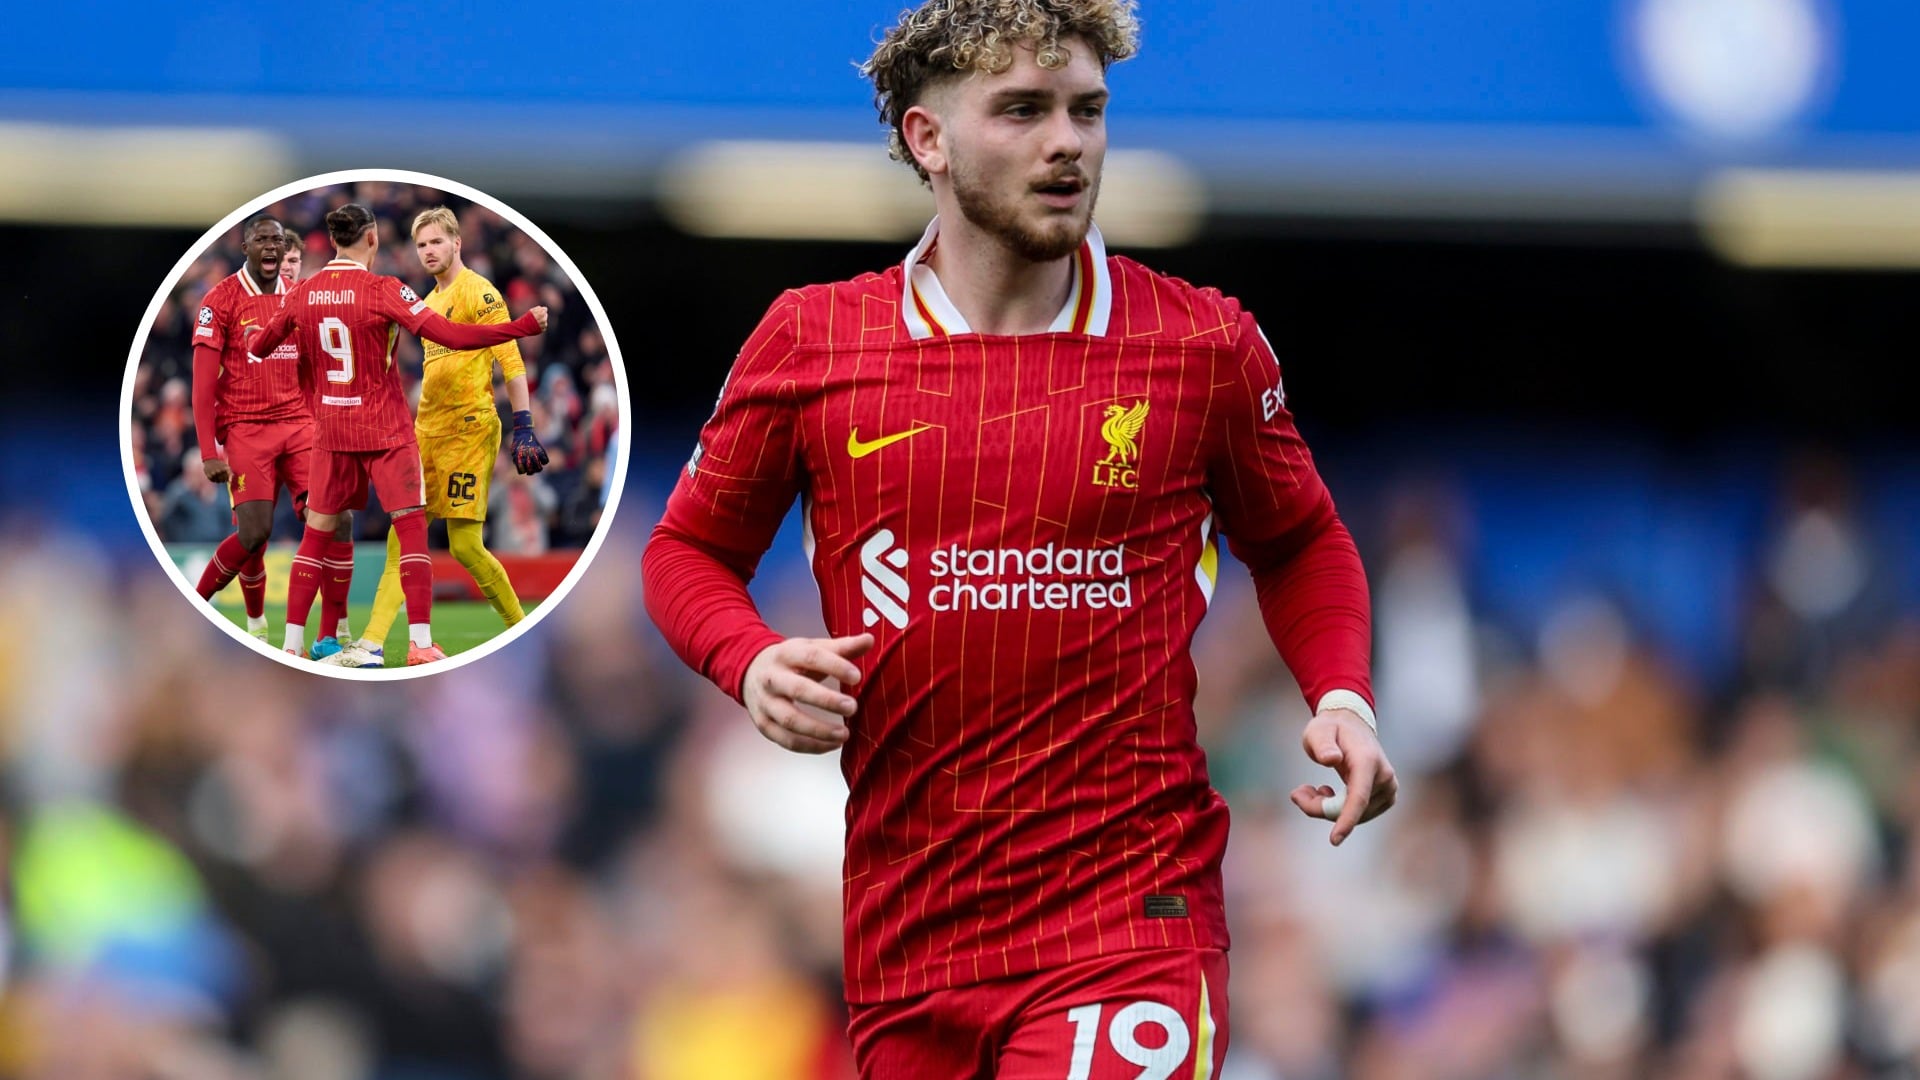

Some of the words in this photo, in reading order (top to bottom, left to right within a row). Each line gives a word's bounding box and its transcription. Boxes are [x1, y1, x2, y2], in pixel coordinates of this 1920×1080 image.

[308, 289, 355, 305] DARWIN
[318, 317, 356, 385] 9
[447, 471, 476, 501] 62
[929, 541, 1125, 577] standard
[928, 575, 1133, 612] chartered
[1066, 1000, 1191, 1080] 19
